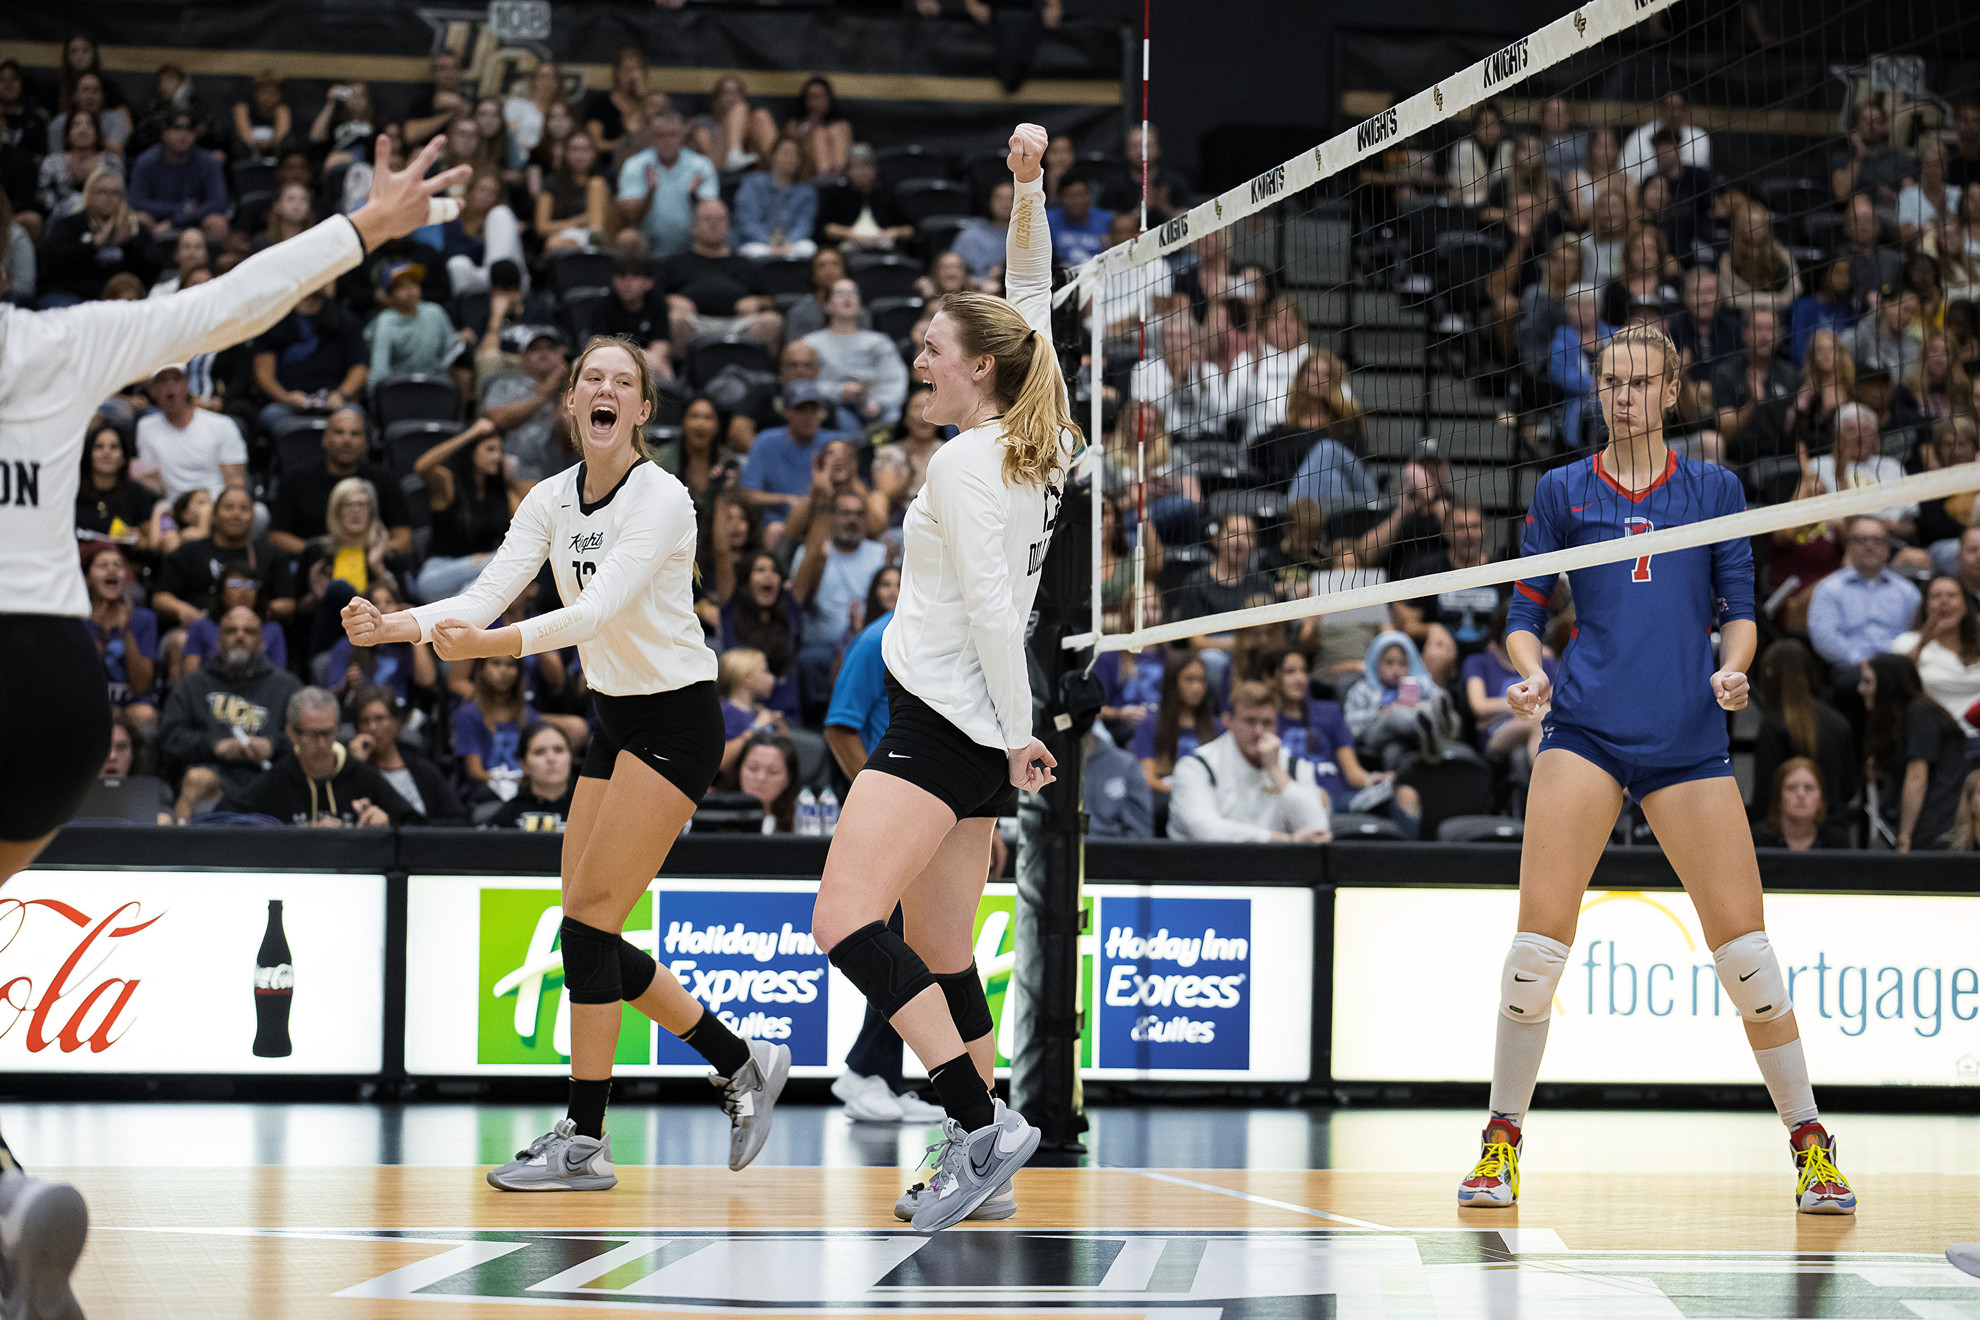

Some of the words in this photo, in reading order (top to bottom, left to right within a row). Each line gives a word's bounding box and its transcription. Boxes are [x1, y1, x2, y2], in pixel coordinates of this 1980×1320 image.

[1251, 164, 1285, 204] KNIGHTS
[1357, 107, 1397, 152] KNIGHTS
[1483, 37, 1529, 88] KNIGHTS
[0, 898, 171, 1053] ola
[664, 921, 779, 962] Holiday
[1201, 928, 1249, 961] Inn
[669, 960, 819, 1013] Express
[1582, 940, 1674, 1017] fbc
[1692, 952, 1979, 1038] mrtgage
